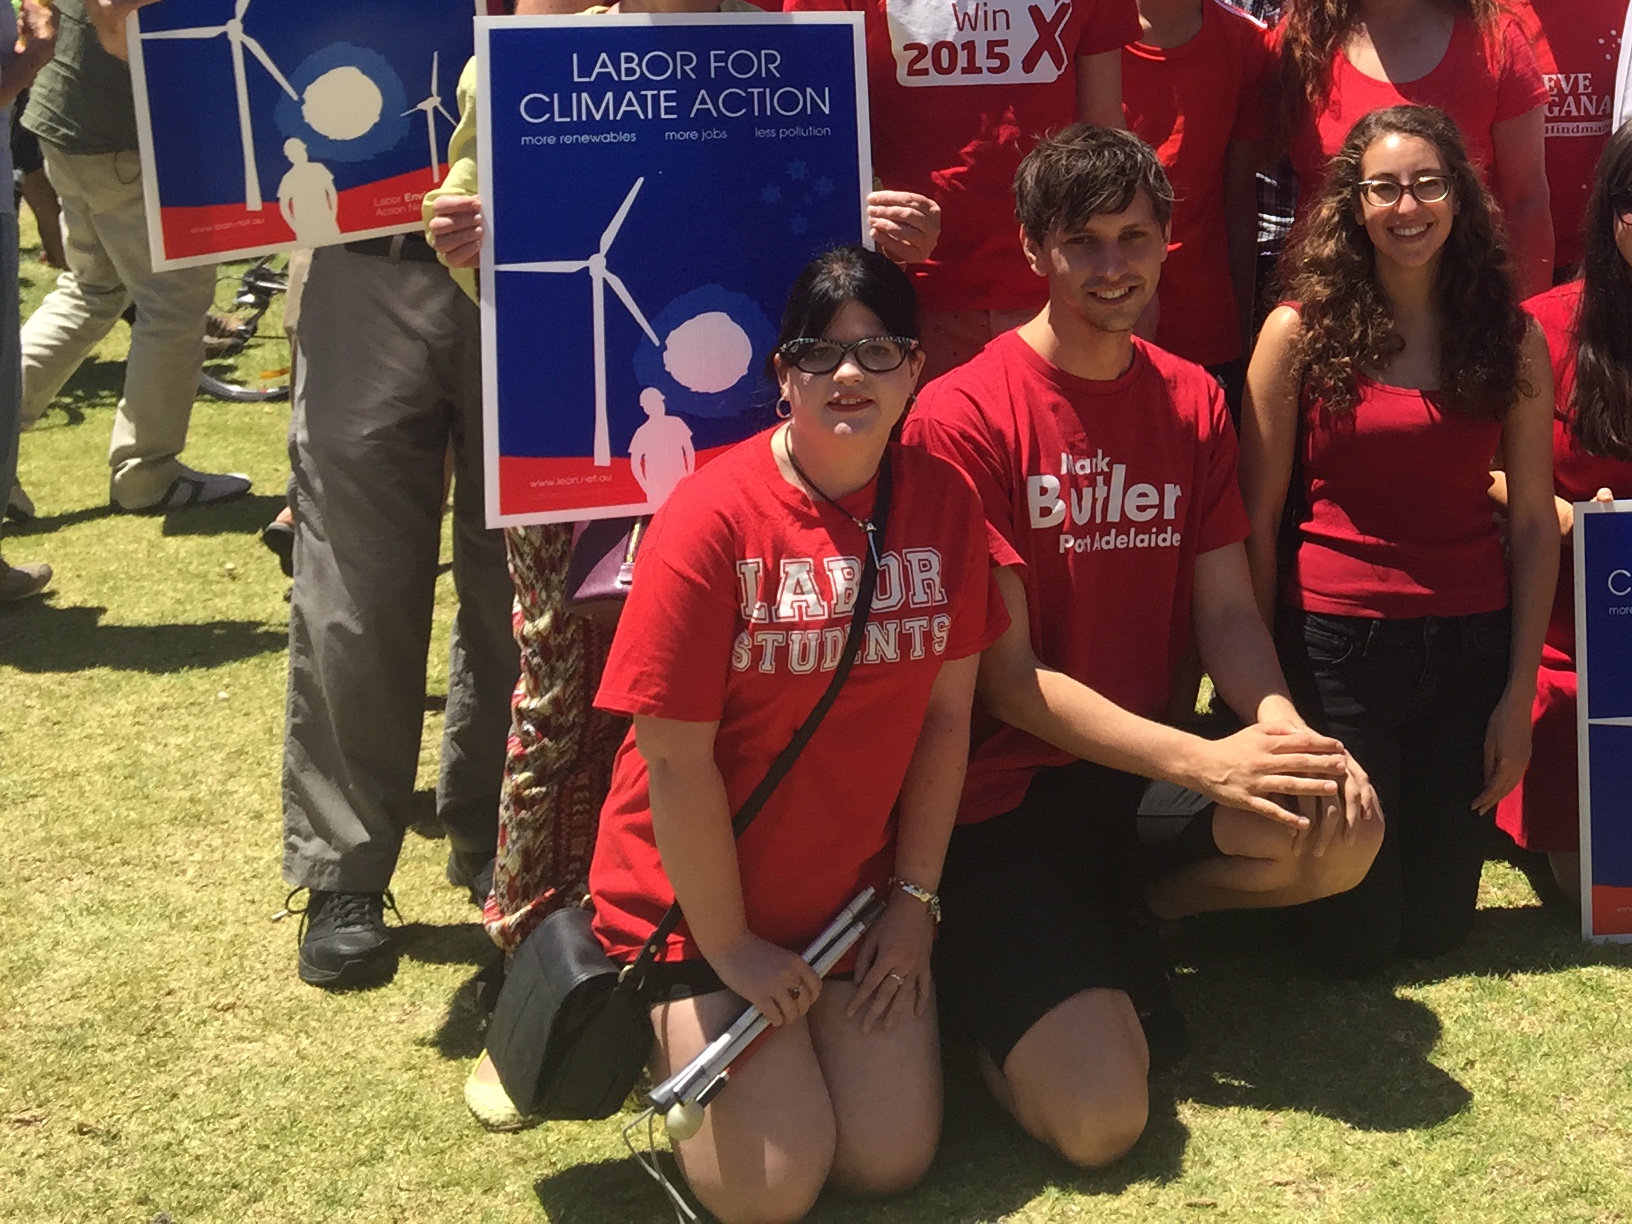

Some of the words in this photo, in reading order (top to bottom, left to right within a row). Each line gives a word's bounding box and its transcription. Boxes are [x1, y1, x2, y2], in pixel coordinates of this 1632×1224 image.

[951, 1, 1011, 32] Win
[572, 50, 697, 82] LABOR
[709, 49, 781, 79] FOR
[902, 39, 1010, 77] 2015
[1542, 73, 1592, 94] EVE
[519, 89, 678, 123] CLIMATE
[689, 86, 830, 118] ACTION
[520, 134, 556, 145] more
[559, 130, 637, 144] renewables
[664, 130, 699, 141] more
[700, 127, 728, 142] jobs
[754, 126, 777, 138] less
[778, 125, 832, 139] pollution
[1027, 464, 1182, 529] Butler
[1092, 526, 1181, 551] Adelaide
[736, 547, 948, 624] LABOR
[732, 613, 951, 674] STUDNTS
